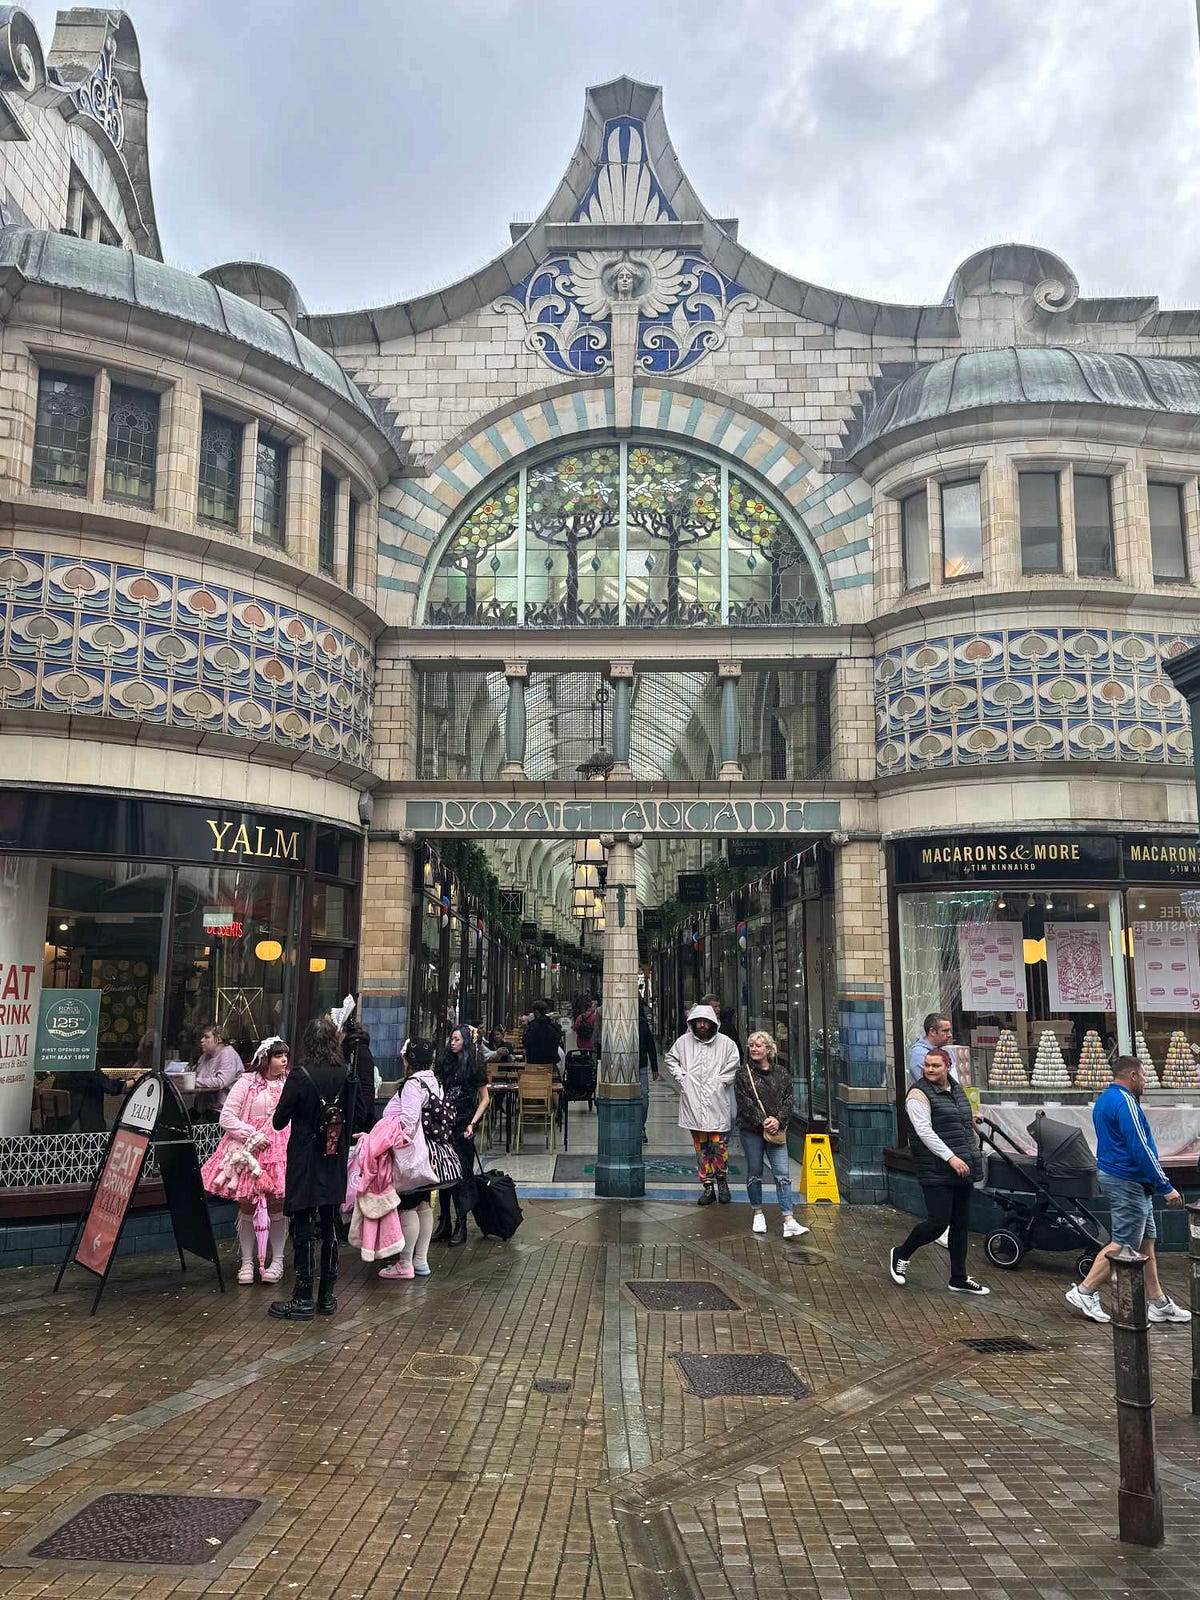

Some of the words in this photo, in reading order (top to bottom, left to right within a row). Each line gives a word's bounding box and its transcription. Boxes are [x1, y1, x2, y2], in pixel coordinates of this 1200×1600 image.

[440, 801, 582, 831] ROYAL
[621, 801, 807, 831] ARCADE
[206, 819, 300, 861] YALM
[922, 845, 1008, 864] MACARONS
[1010, 844, 1034, 861] &
[1034, 844, 1081, 860] MORE
[971, 864, 987, 872] TIM
[992, 863, 1036, 872] KINNAIRD
[0, 963, 36, 1000] AT
[0, 1004, 32, 1026] RINK
[130, 1103, 156, 1122] YALM
[110, 1140, 144, 1177] EAT
[103, 1170, 133, 1198] DRINK
